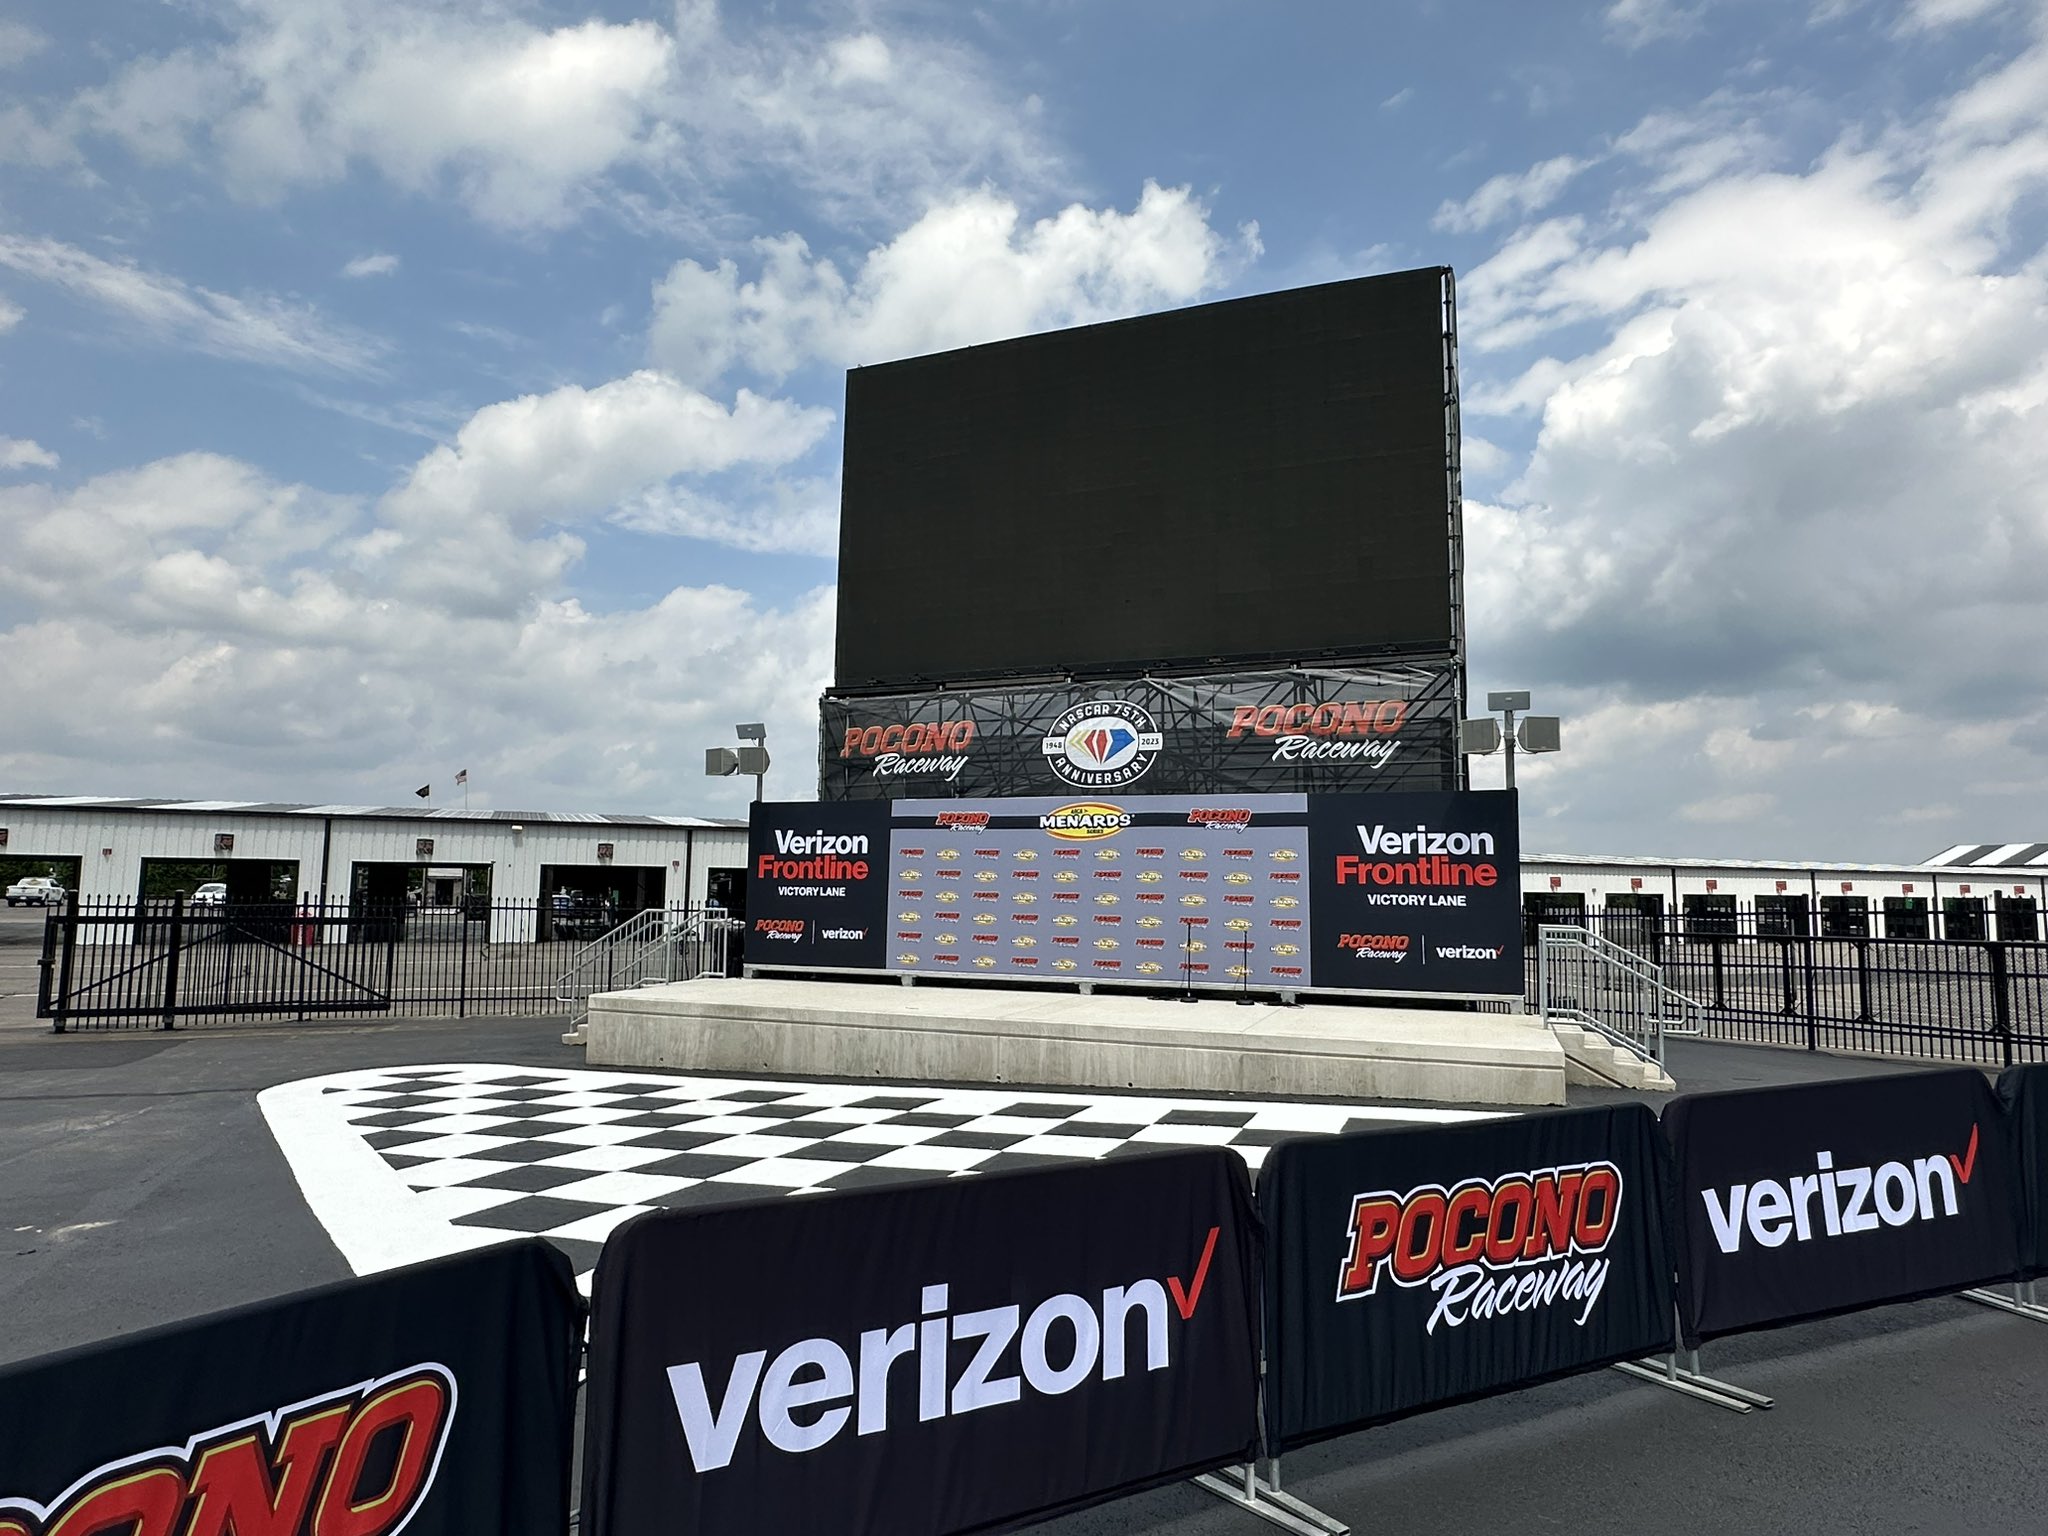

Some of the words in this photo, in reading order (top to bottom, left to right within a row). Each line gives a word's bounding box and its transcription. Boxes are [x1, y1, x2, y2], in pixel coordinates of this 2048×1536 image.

[1059, 704, 1109, 731] NASCAR
[1114, 704, 1147, 728] 75TH
[1226, 700, 1408, 739] POCONO
[840, 719, 976, 758] POCONO
[1272, 734, 1401, 769] Raceway
[872, 752, 969, 782] Raceway
[1055, 753, 1148, 784] ANNIVERSARY
[935, 811, 990, 825] POCONO
[1039, 814, 1131, 828] MENARDS
[1187, 808, 1251, 823] POCONO
[775, 830, 869, 854] Verizon
[1357, 825, 1495, 855] Verizon
[758, 855, 869, 880] Frontline
[1336, 855, 1498, 886] Frontline
[778, 886, 819, 897] VICTORY
[820, 887, 846, 897] LANE
[1367, 894, 1428, 906] VICTORY
[1428, 895, 1467, 906] LANE
[754, 919, 804, 933] POCONO
[822, 928, 863, 940] verizon
[1337, 934, 1410, 949] POCONO
[1436, 945, 1497, 960] verizon
[1356, 947, 1407, 963] Raceway
[1701, 1150, 1959, 1254] verizon
[1336, 1160, 1622, 1301] POCONO
[1426, 1249, 1610, 1336] Raceway
[667, 1283, 1168, 1473] verizon
